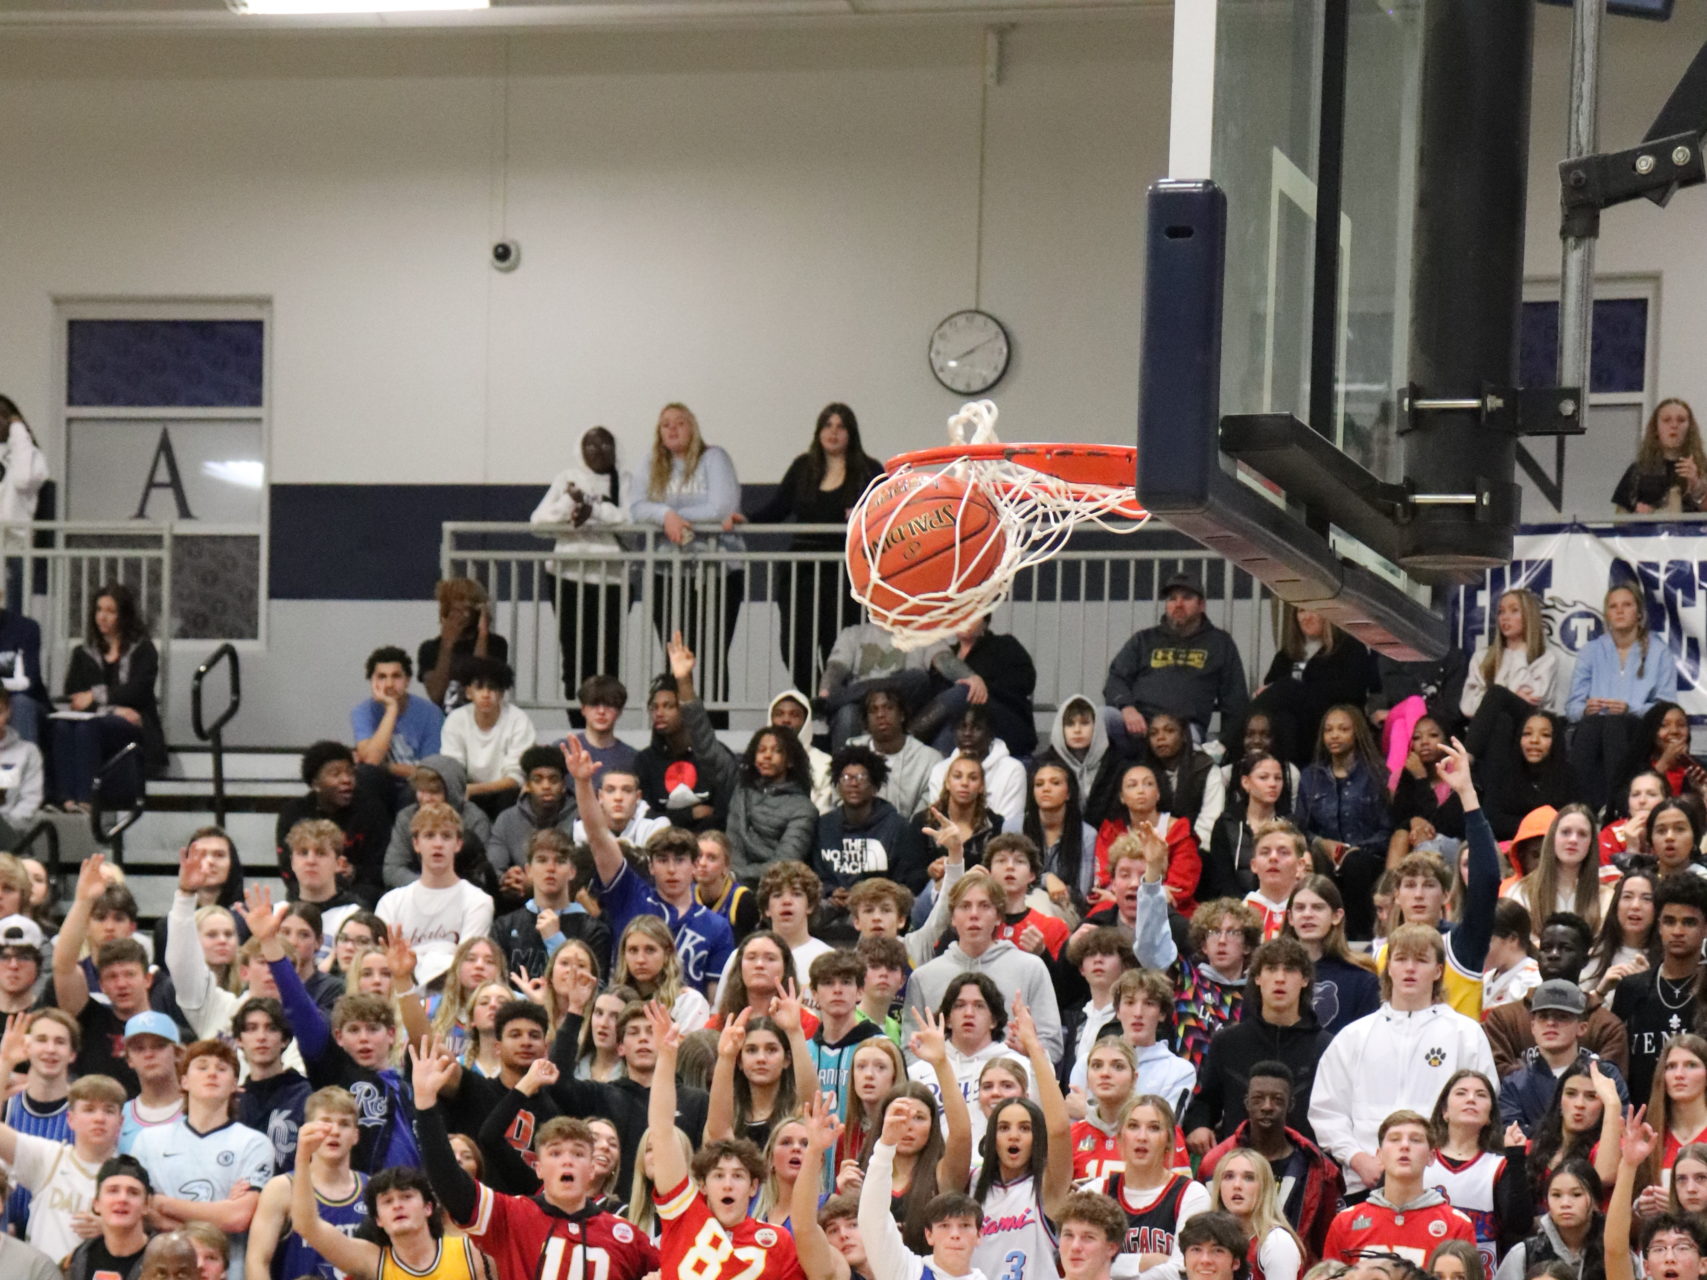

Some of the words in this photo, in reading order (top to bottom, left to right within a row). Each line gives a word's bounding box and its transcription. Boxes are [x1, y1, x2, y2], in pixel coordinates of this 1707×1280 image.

[130, 424, 198, 520] A
[1570, 617, 1596, 649] T
[842, 838, 867, 850] THE
[821, 849, 866, 862] NORTH
